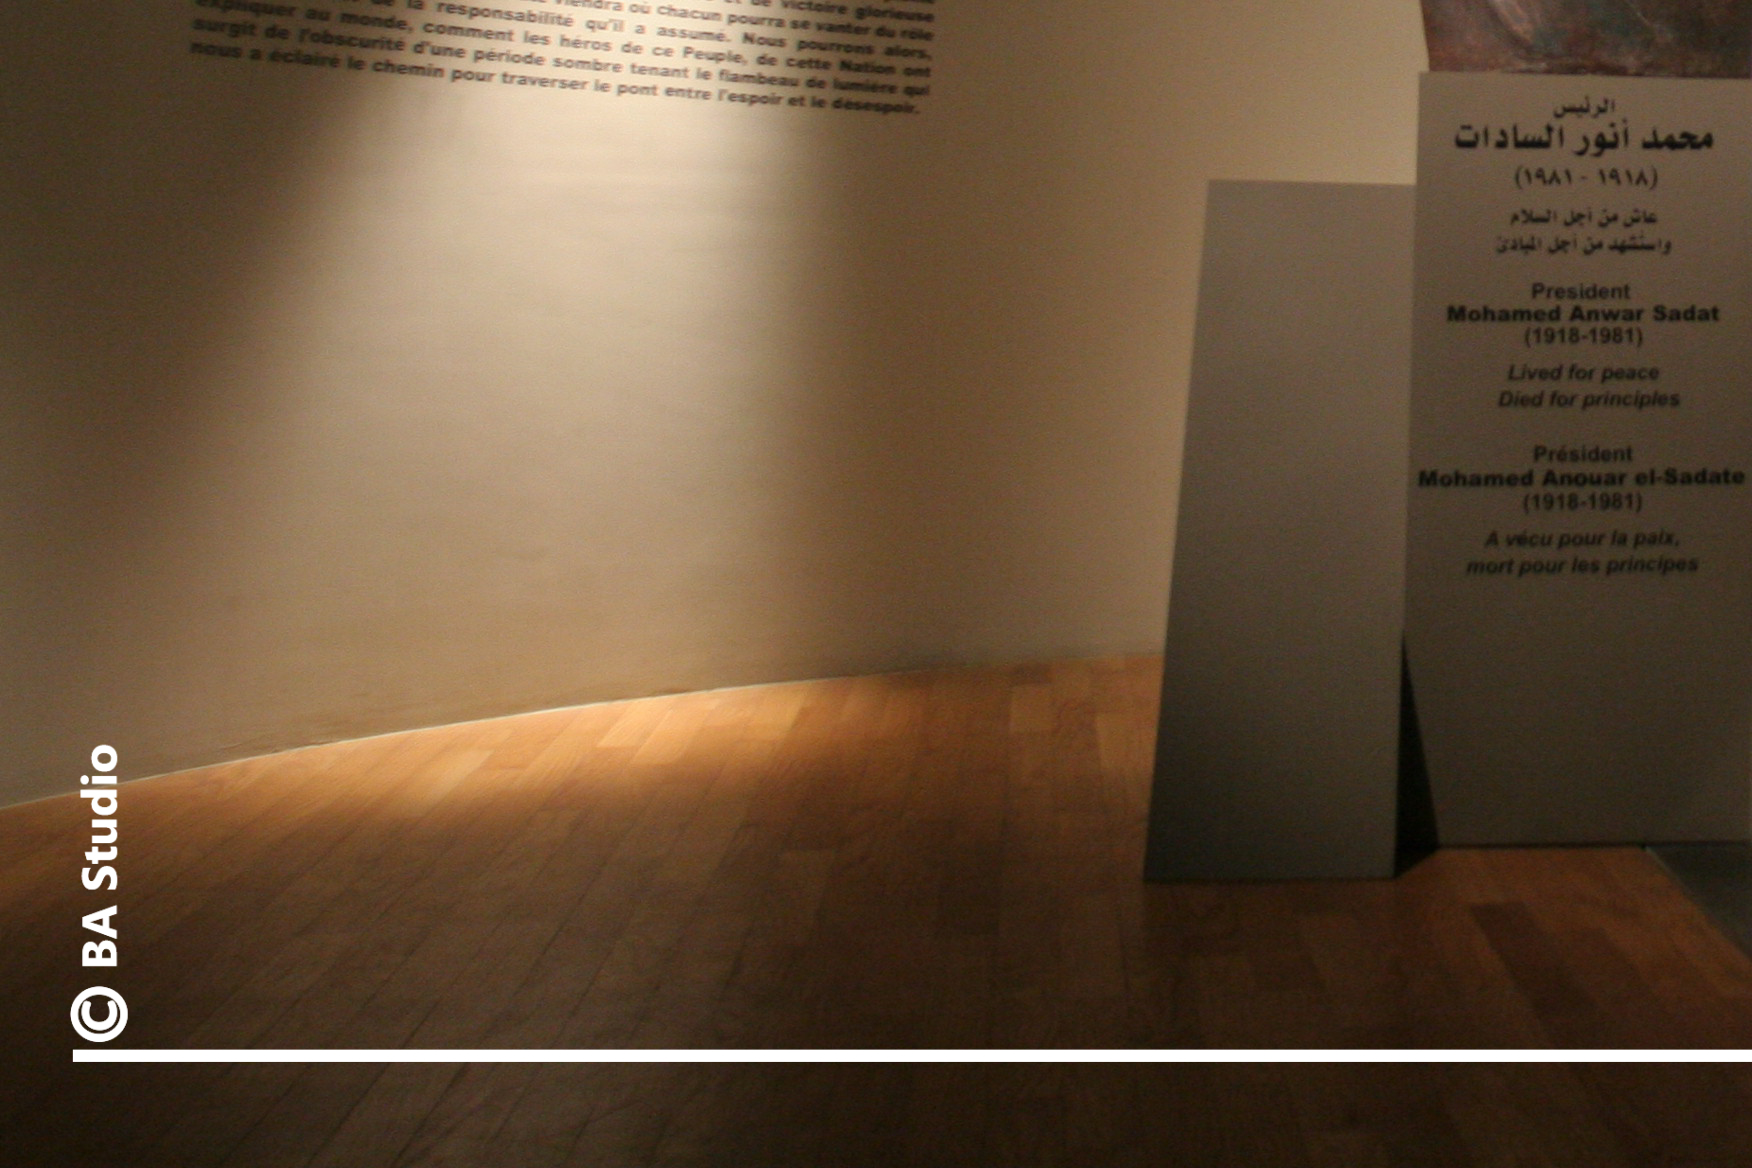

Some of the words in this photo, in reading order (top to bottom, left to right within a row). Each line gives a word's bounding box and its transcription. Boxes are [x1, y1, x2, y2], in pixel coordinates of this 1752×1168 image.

[1532, 283, 1630, 301] President
[1447, 304, 1560, 322] Mohamed
[1570, 306, 1643, 322] Anwar
[1653, 306, 1719, 322] Sadat
[1524, 327, 1643, 348] (1918-1981)
[1508, 364, 1562, 381] Lived
[1568, 364, 1597, 380] for
[1601, 367, 1659, 383] peace
[1498, 391, 1543, 408] Died
[1549, 391, 1577, 407] for
[1582, 392, 1680, 411] principles
[1534, 445, 1633, 462] Président
[1418, 469, 1533, 487] Mohamed
[1543, 470, 1627, 486] Anouar
[1635, 467, 1745, 485] el-Sadate
[1523, 492, 1642, 514] (1918-1981)
[1484, 530, 1499, 547] A
[1506, 530, 1552, 546] vécu
[1558, 532, 1605, 551] pour
[1611, 530, 1628, 546] la
[1466, 557, 1514, 574] mort
[1518, 559, 1566, 577] pour
[1572, 556, 1600, 573] les
[1606, 556, 1698, 576] principes
